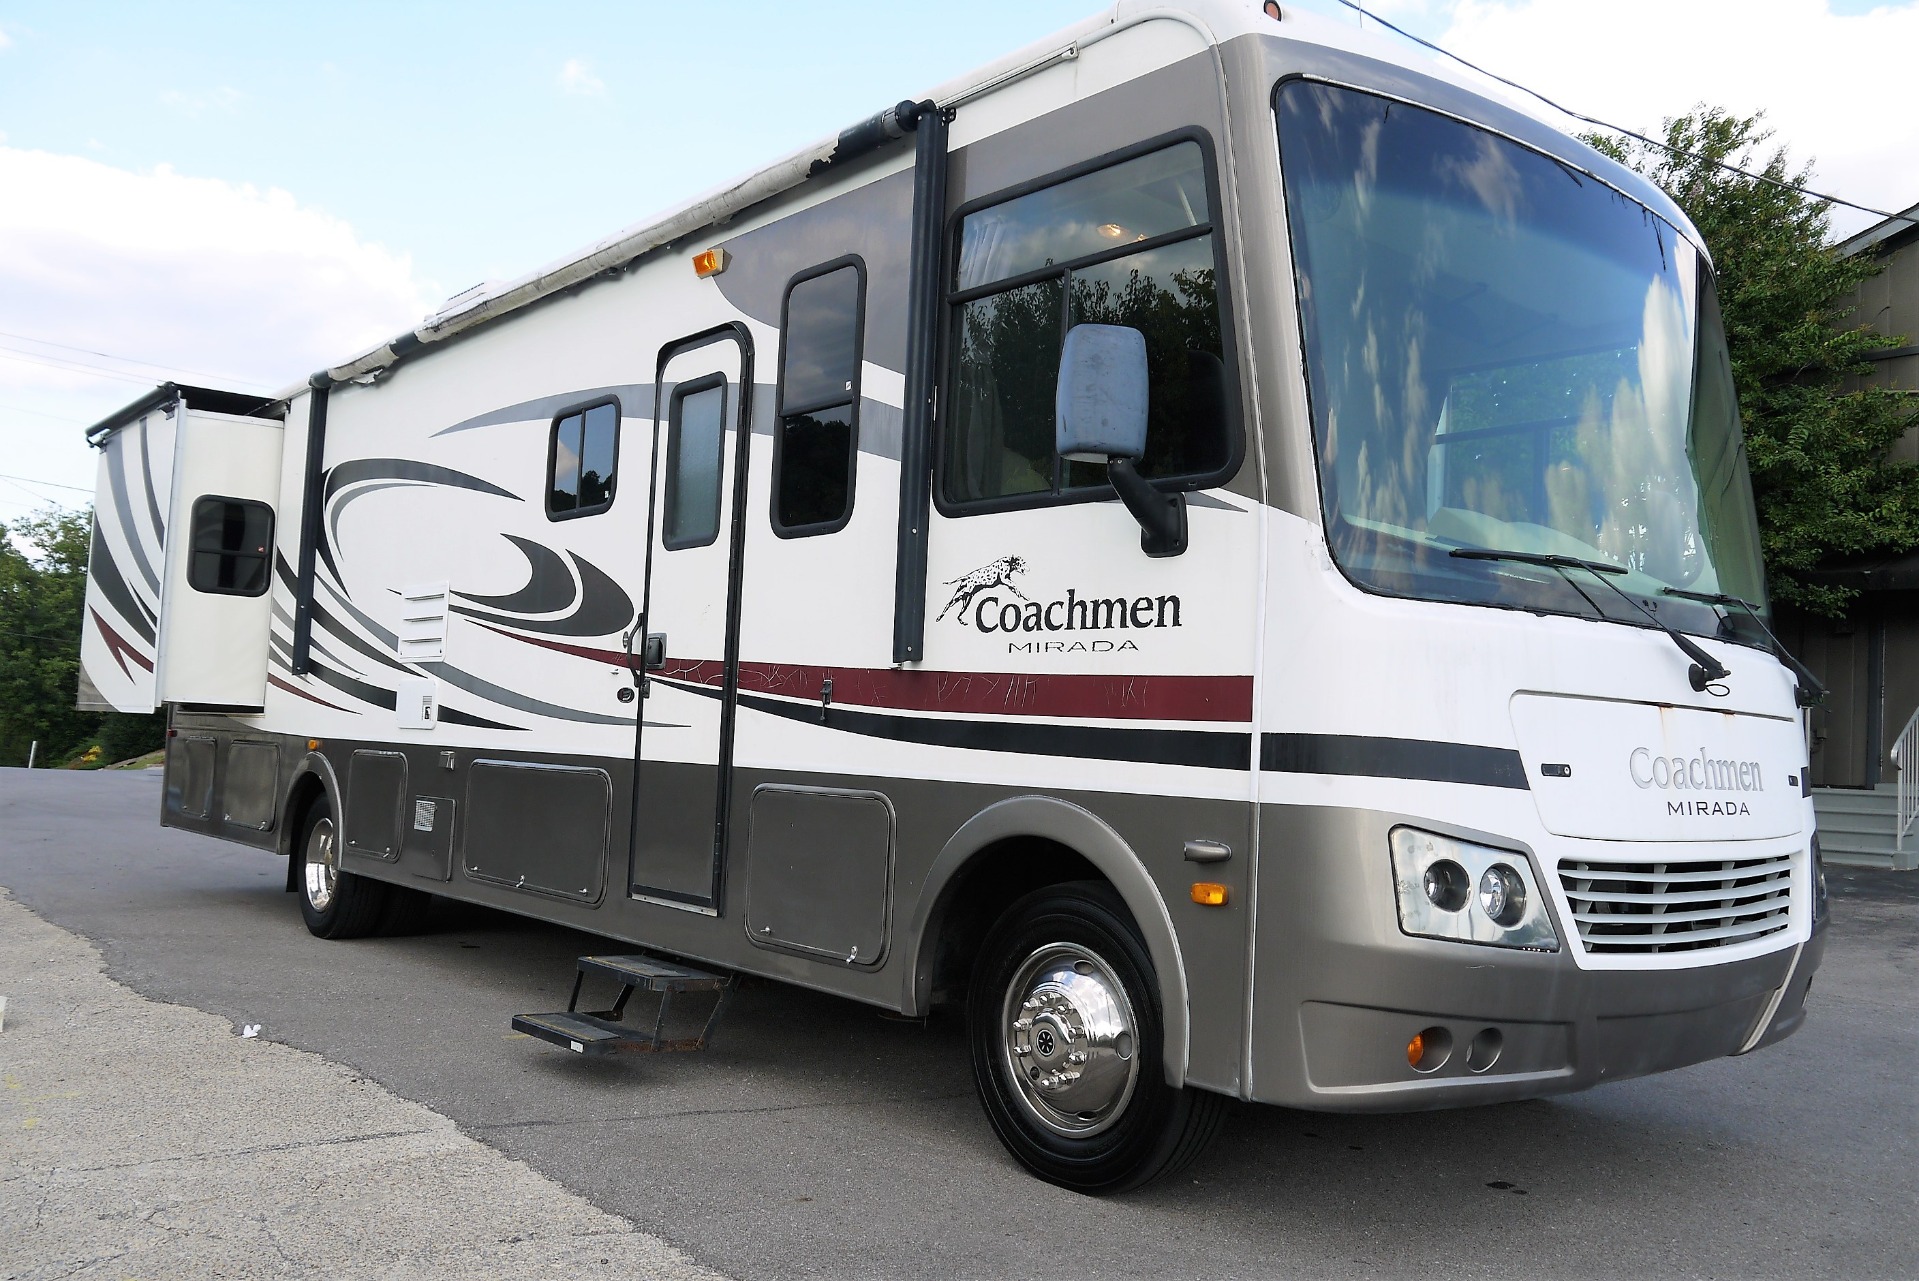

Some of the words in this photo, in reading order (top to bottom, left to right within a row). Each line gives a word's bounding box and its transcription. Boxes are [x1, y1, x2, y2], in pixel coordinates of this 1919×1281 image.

[975, 589, 1182, 633] Coachmen
[1008, 639, 1140, 654] MIRADA
[1629, 747, 1764, 792] Coachmen
[1667, 801, 1751, 816] MIRADA
